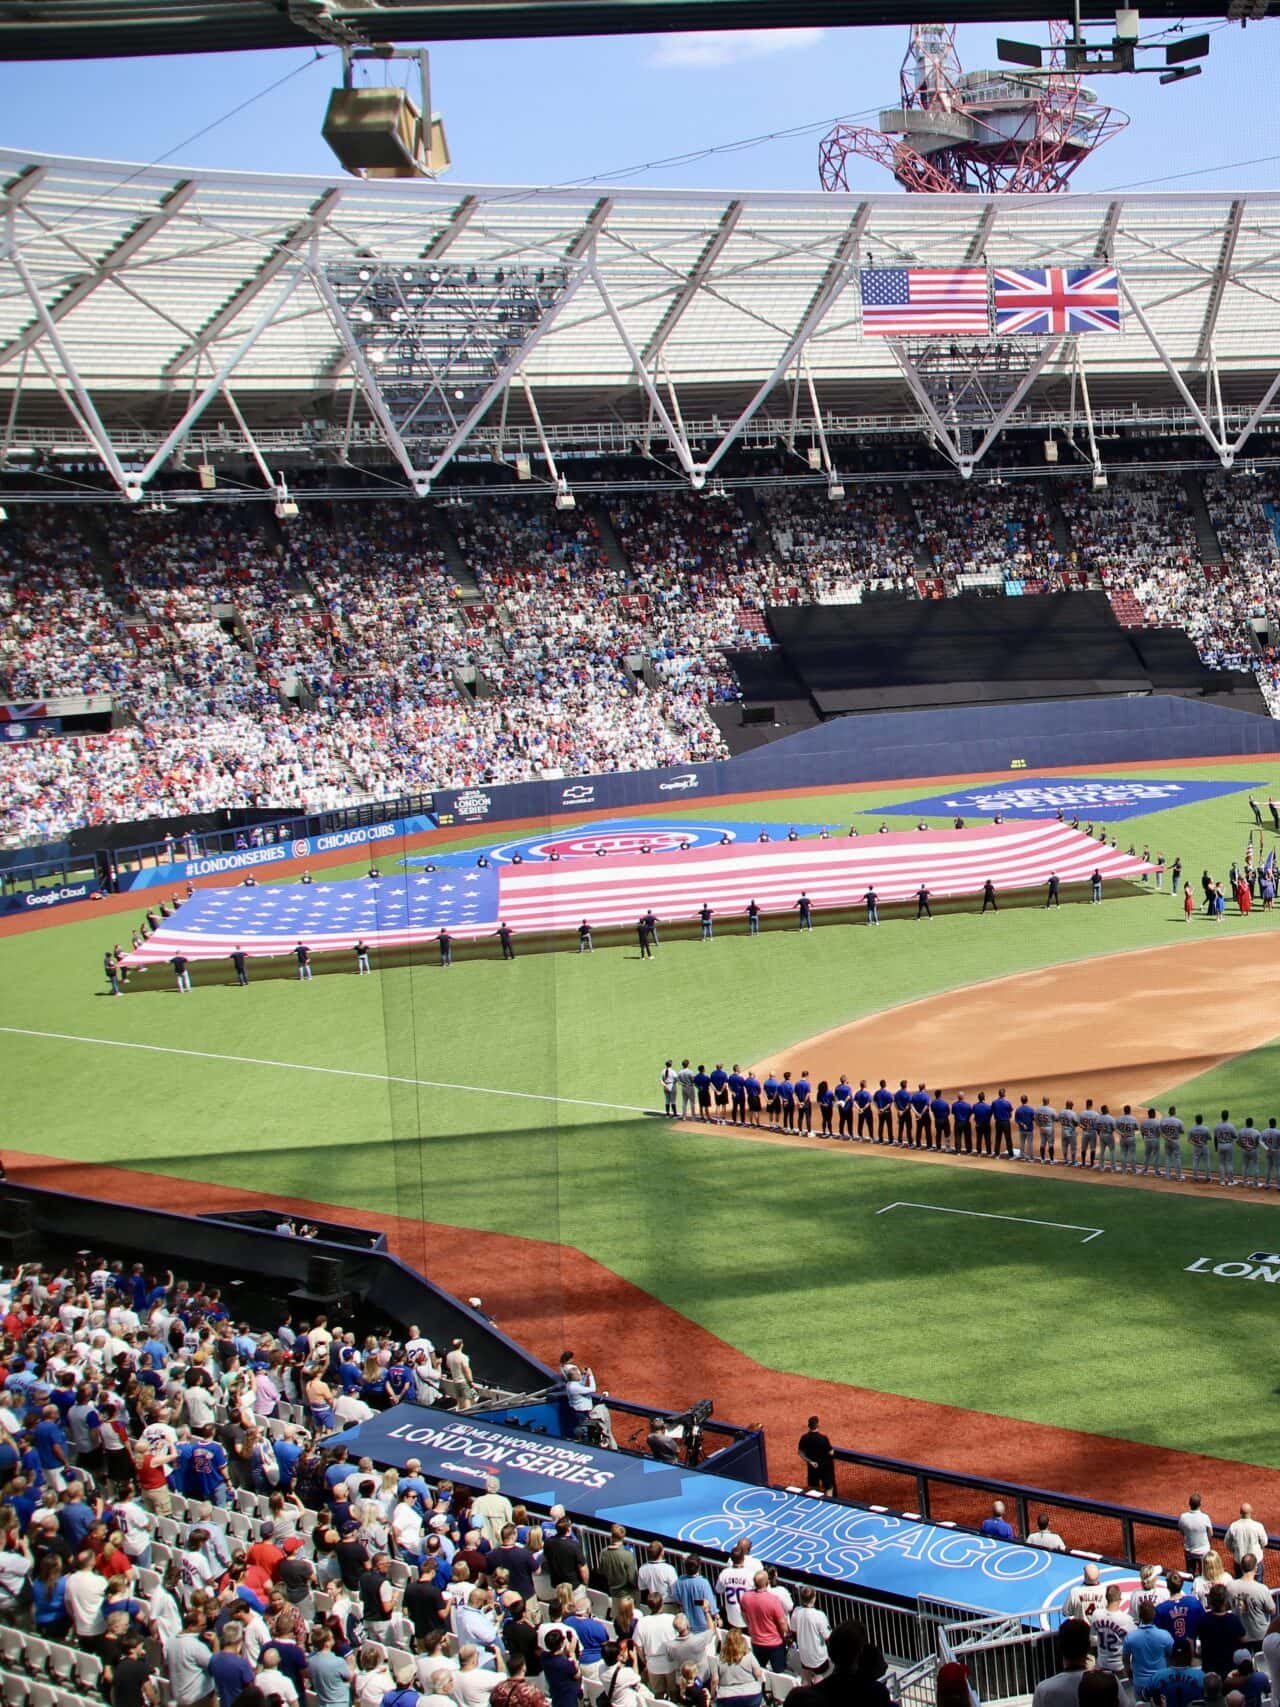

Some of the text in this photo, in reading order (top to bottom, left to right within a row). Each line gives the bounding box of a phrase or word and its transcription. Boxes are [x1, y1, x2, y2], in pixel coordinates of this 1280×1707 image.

[317, 829, 366, 849] CHICAGO
[367, 823, 395, 839] CUBS
[185, 847, 285, 876] #LONDONSERIES
[26, 885, 86, 905] Google Cloud
[387, 1423, 615, 1489] LONDON SERIES
[471, 1428, 595, 1465] MLB WORLD TOUR
[721, 1486, 1052, 1581] CHICAGO
[678, 1514, 875, 1581] CUBS
[723, 1575, 747, 1586] LONDON
[1098, 1628, 1119, 1652] 12
[1174, 1617, 1186, 1637] 9
